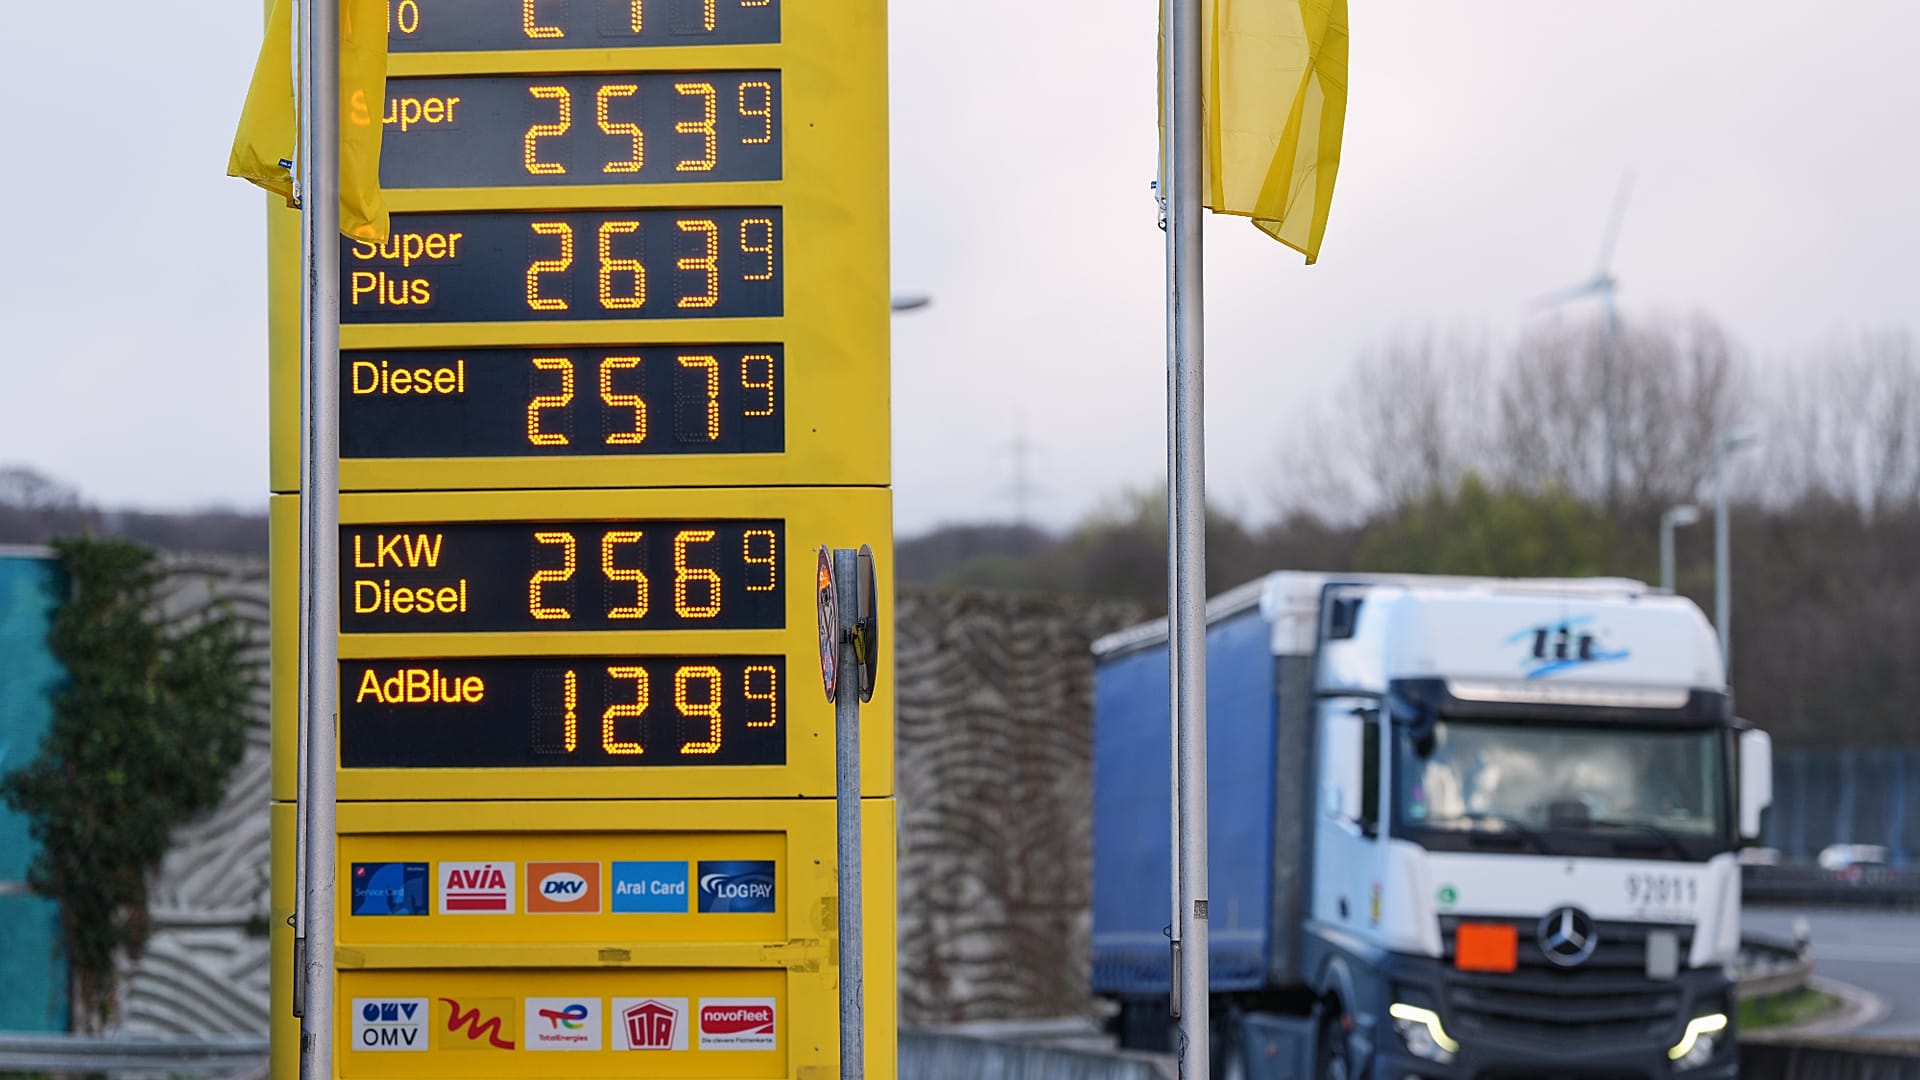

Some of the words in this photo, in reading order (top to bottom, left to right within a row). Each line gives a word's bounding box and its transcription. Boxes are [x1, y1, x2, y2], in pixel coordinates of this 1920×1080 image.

[351, 88, 460, 132] Super
[351, 226, 463, 268] Super
[351, 271, 430, 305] Plus
[352, 359, 464, 395] Diesel
[354, 533, 443, 568] LKW
[354, 578, 467, 614] Diesel
[356, 668, 485, 704] AdBlue
[355, 887, 384, 897] Service
[386, 887, 404, 897] Card
[543, 880, 584, 894] DKV
[616, 880, 646, 895] Aral
[650, 880, 685, 895] Card
[717, 883, 773, 899] LOGPAY
[627, 1003, 674, 1047] UTA
[704, 1009, 769, 1022] novofleet
[362, 1028, 419, 1046] OMV
[539, 1033, 589, 1043] TotalEnergies
